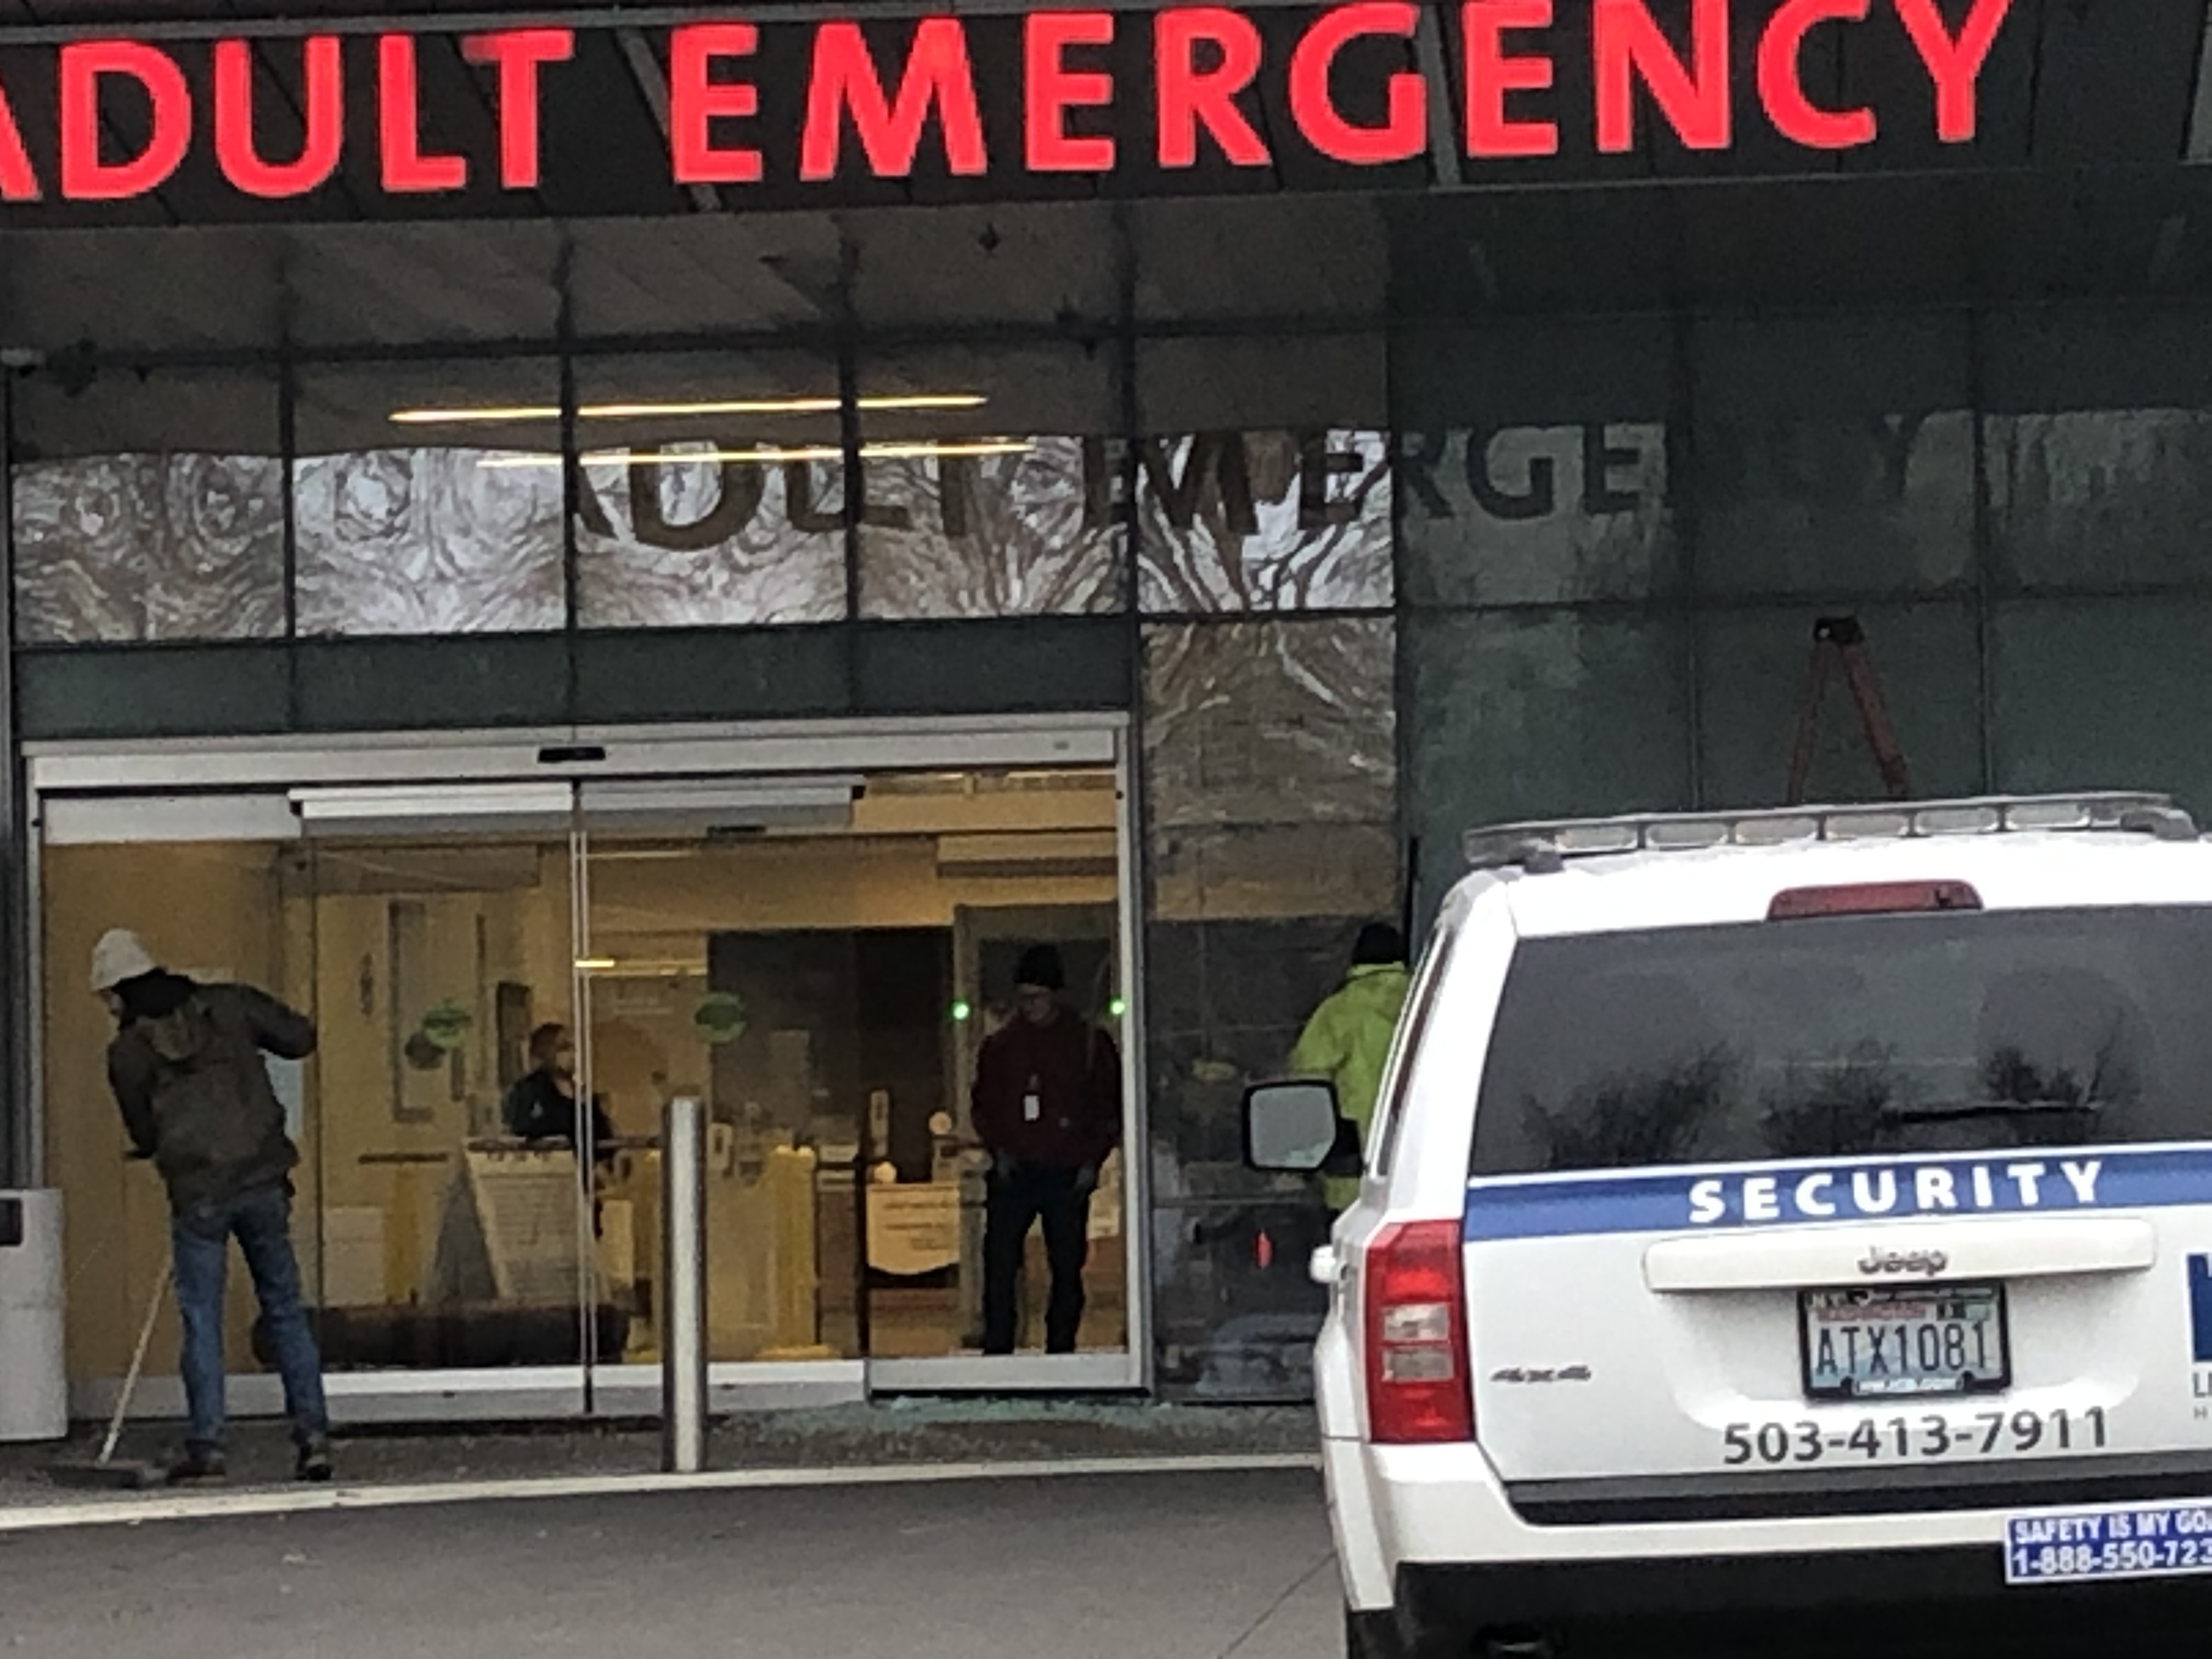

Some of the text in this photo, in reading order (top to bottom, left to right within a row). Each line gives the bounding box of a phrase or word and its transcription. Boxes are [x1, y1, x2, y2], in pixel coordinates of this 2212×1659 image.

[669, 0, 2011, 182] EMERGENCY
[1688, 1161, 2102, 1223] SECURITY
[1857, 1245, 1948, 1277] Jeep
[1815, 1323, 1985, 1376] ATX1081
[2192, 1371, 2212, 1398] L
[1723, 1405, 2107, 1466] 503-413-7911
[2015, 1509, 2212, 1544] SAFETY IS MY GO
